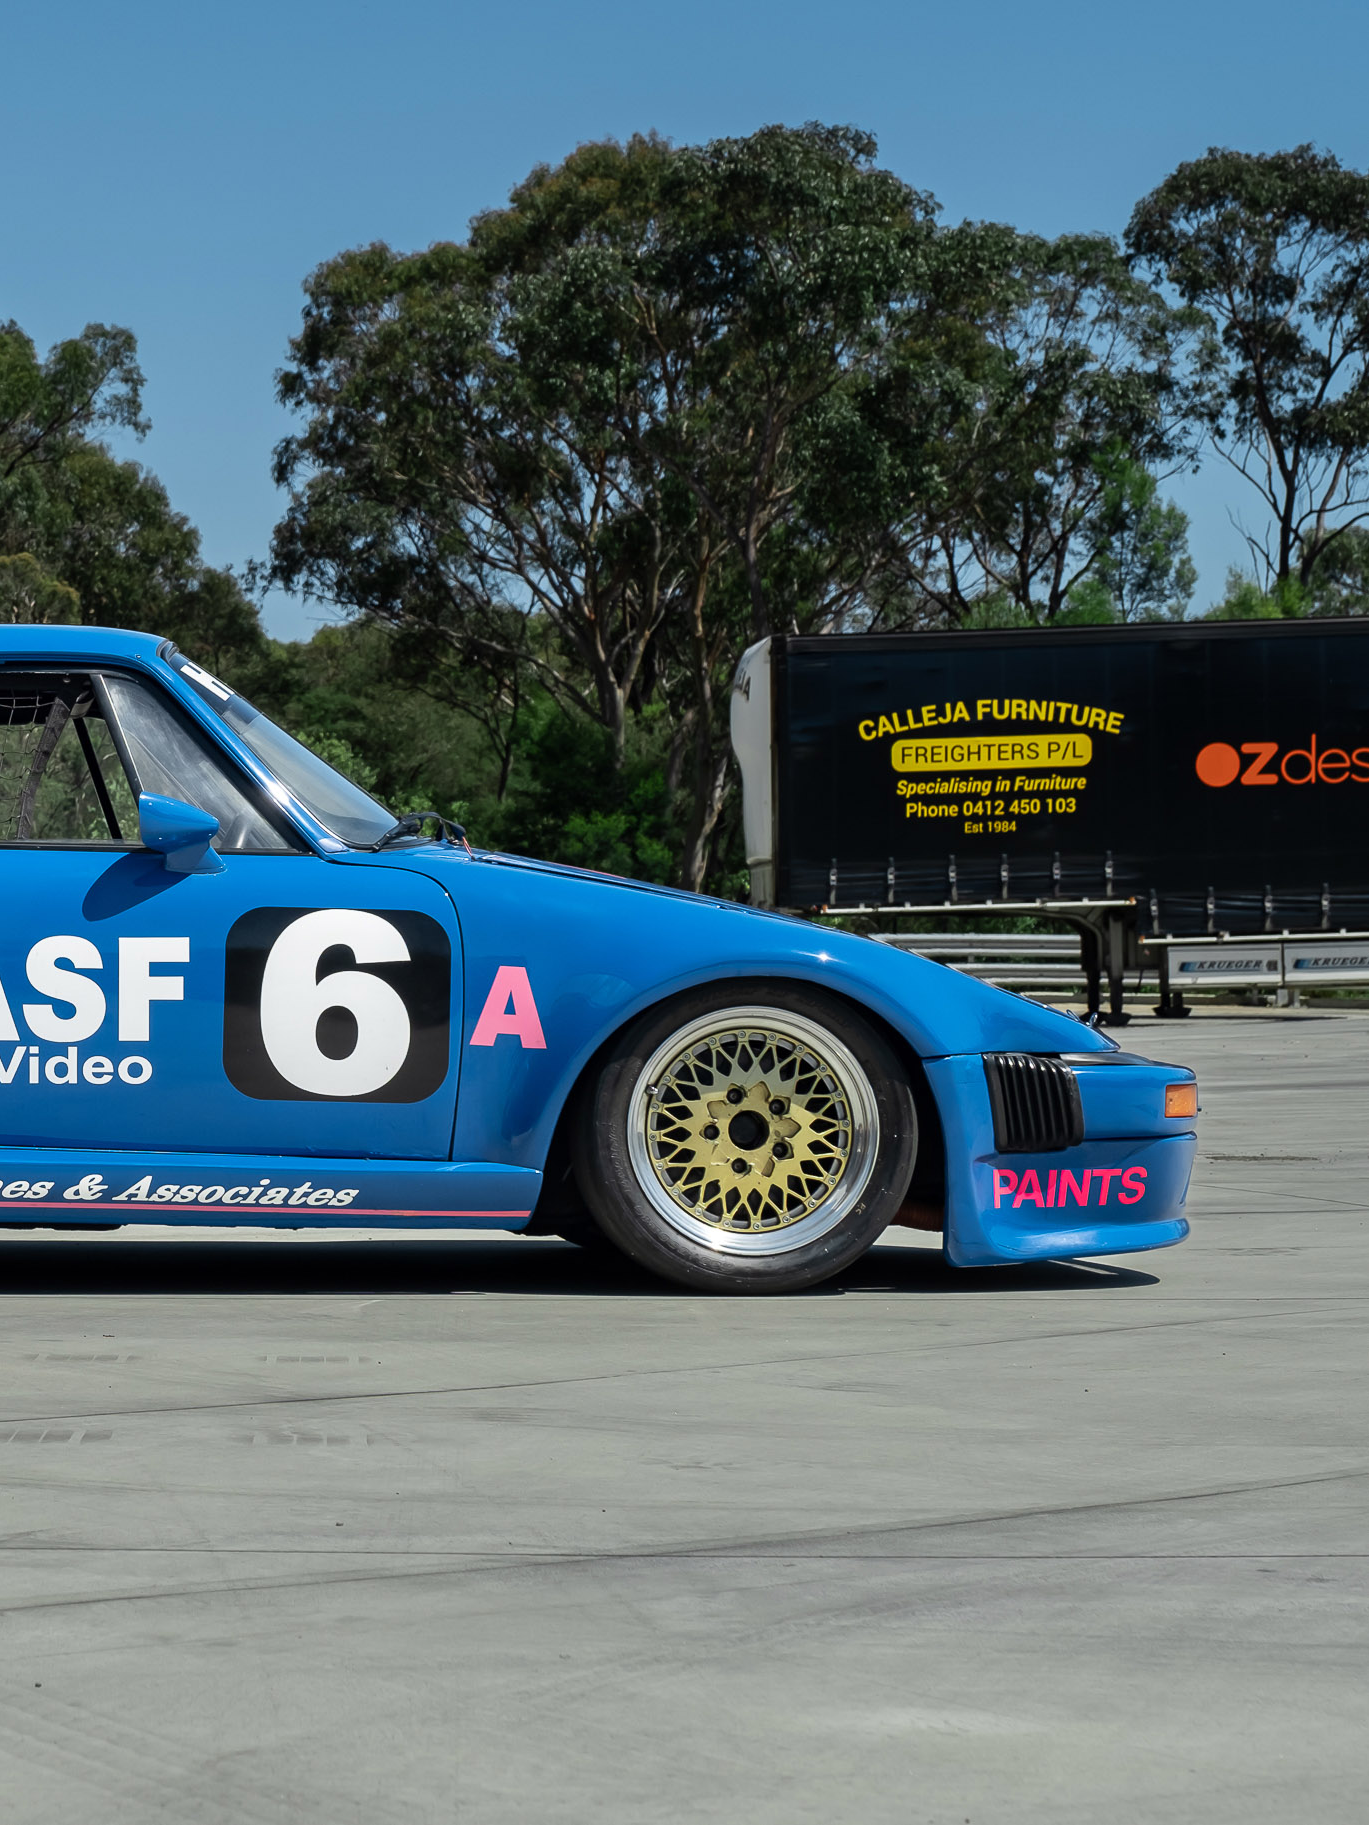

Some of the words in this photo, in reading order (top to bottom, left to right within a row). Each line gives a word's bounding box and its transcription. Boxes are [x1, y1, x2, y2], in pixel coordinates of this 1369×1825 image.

[858, 701, 970, 740] CALLEJA
[977, 699, 1124, 734] FURNITURE
[901, 742, 1040, 764] FREIGHTERS
[1047, 741, 1084, 760] P/L
[896, 777, 992, 798] Specialising
[995, 776, 1010, 792] in
[1013, 774, 1087, 791] Furniture
[906, 802, 959, 818] Phone
[962, 800, 1005, 816] 0412
[1009, 798, 1041, 815] 450
[1047, 797, 1077, 814] 103
[964, 821, 983, 833] Est
[987, 820, 1017, 833] 1984
[1197, 960, 1263, 969] KRUEGER
[1312, 956, 1369, 966] KRUEGE
[259, 909, 412, 1097] 6
[470, 966, 548, 1050] A
[62, 1174, 109, 1201] &
[112, 1175, 359, 1206] Associates
[992, 1166, 1148, 1209] PAINTS
